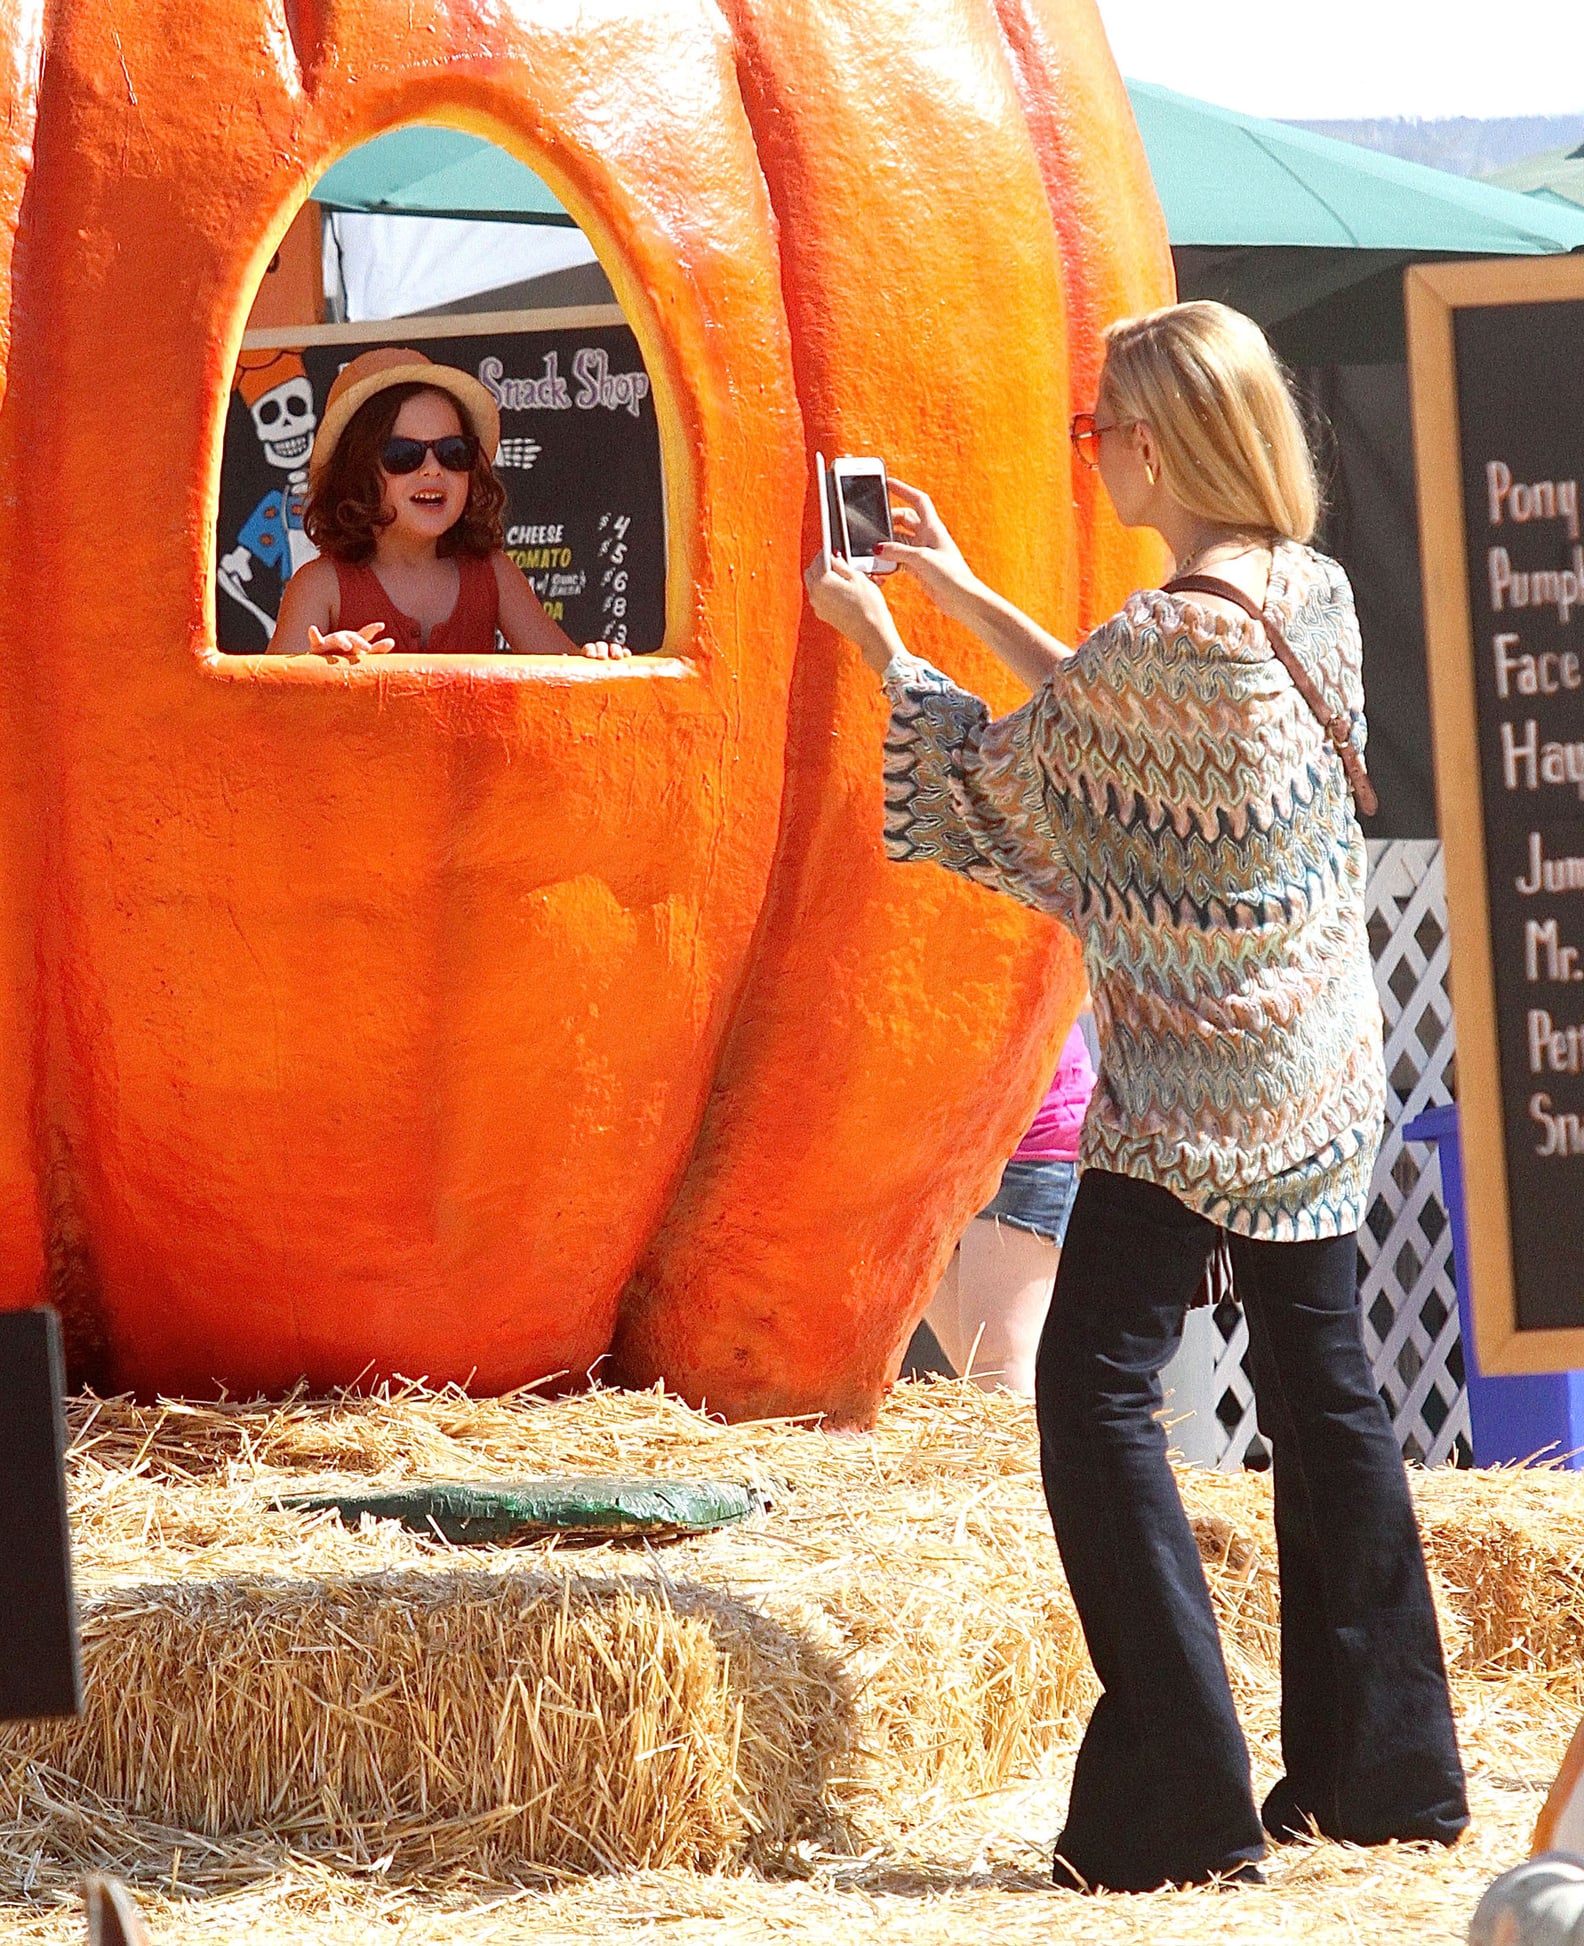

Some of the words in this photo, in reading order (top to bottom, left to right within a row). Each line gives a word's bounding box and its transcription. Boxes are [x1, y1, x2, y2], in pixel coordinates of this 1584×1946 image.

[479, 351, 572, 411] Snack
[573, 348, 648, 416] Shop
[1486, 460, 1580, 540] Pony
[506, 547, 572, 568] TOMATO
[507, 524, 564, 545] CHEESE
[1493, 632, 1582, 699] Face
[1524, 919, 1584, 981] Mr.
